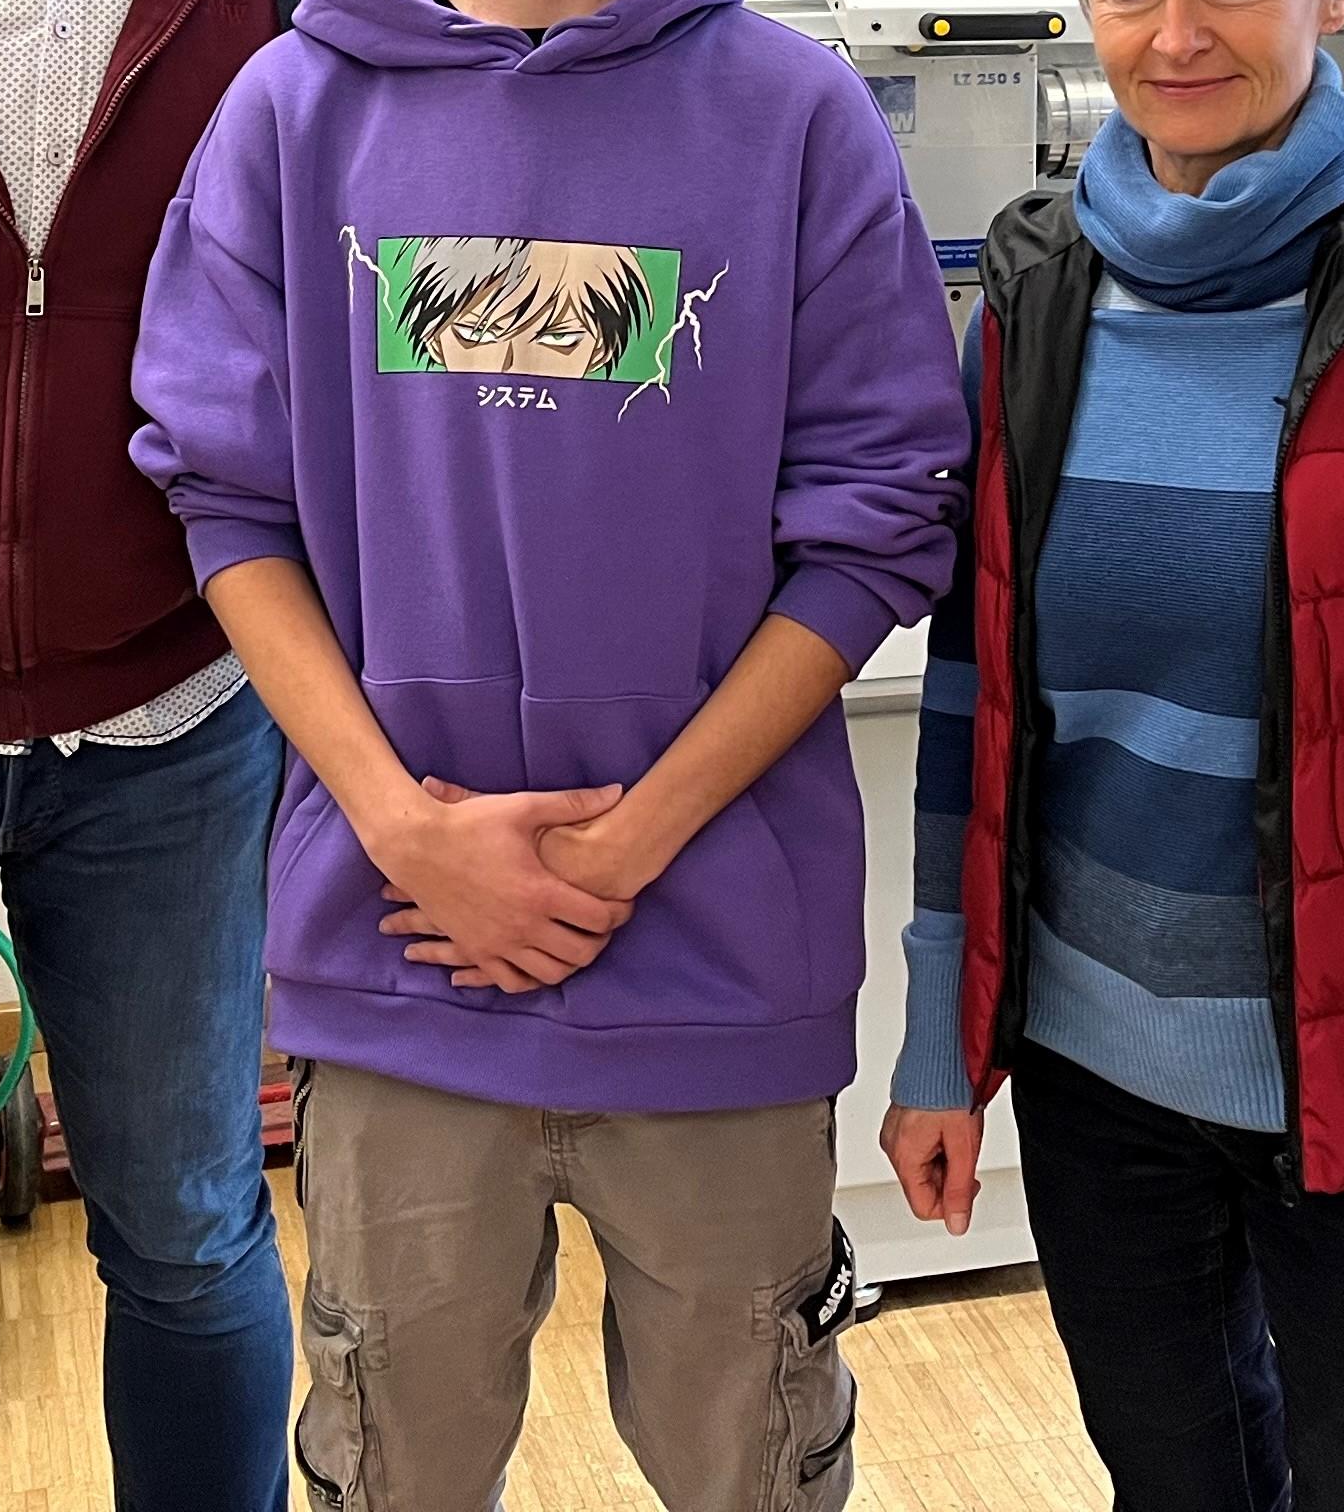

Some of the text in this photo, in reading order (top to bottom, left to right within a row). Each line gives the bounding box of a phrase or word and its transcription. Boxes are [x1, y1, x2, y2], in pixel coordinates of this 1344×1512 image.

[977, 72, 1007, 86] 250
[477, 385, 558, 410] システム
